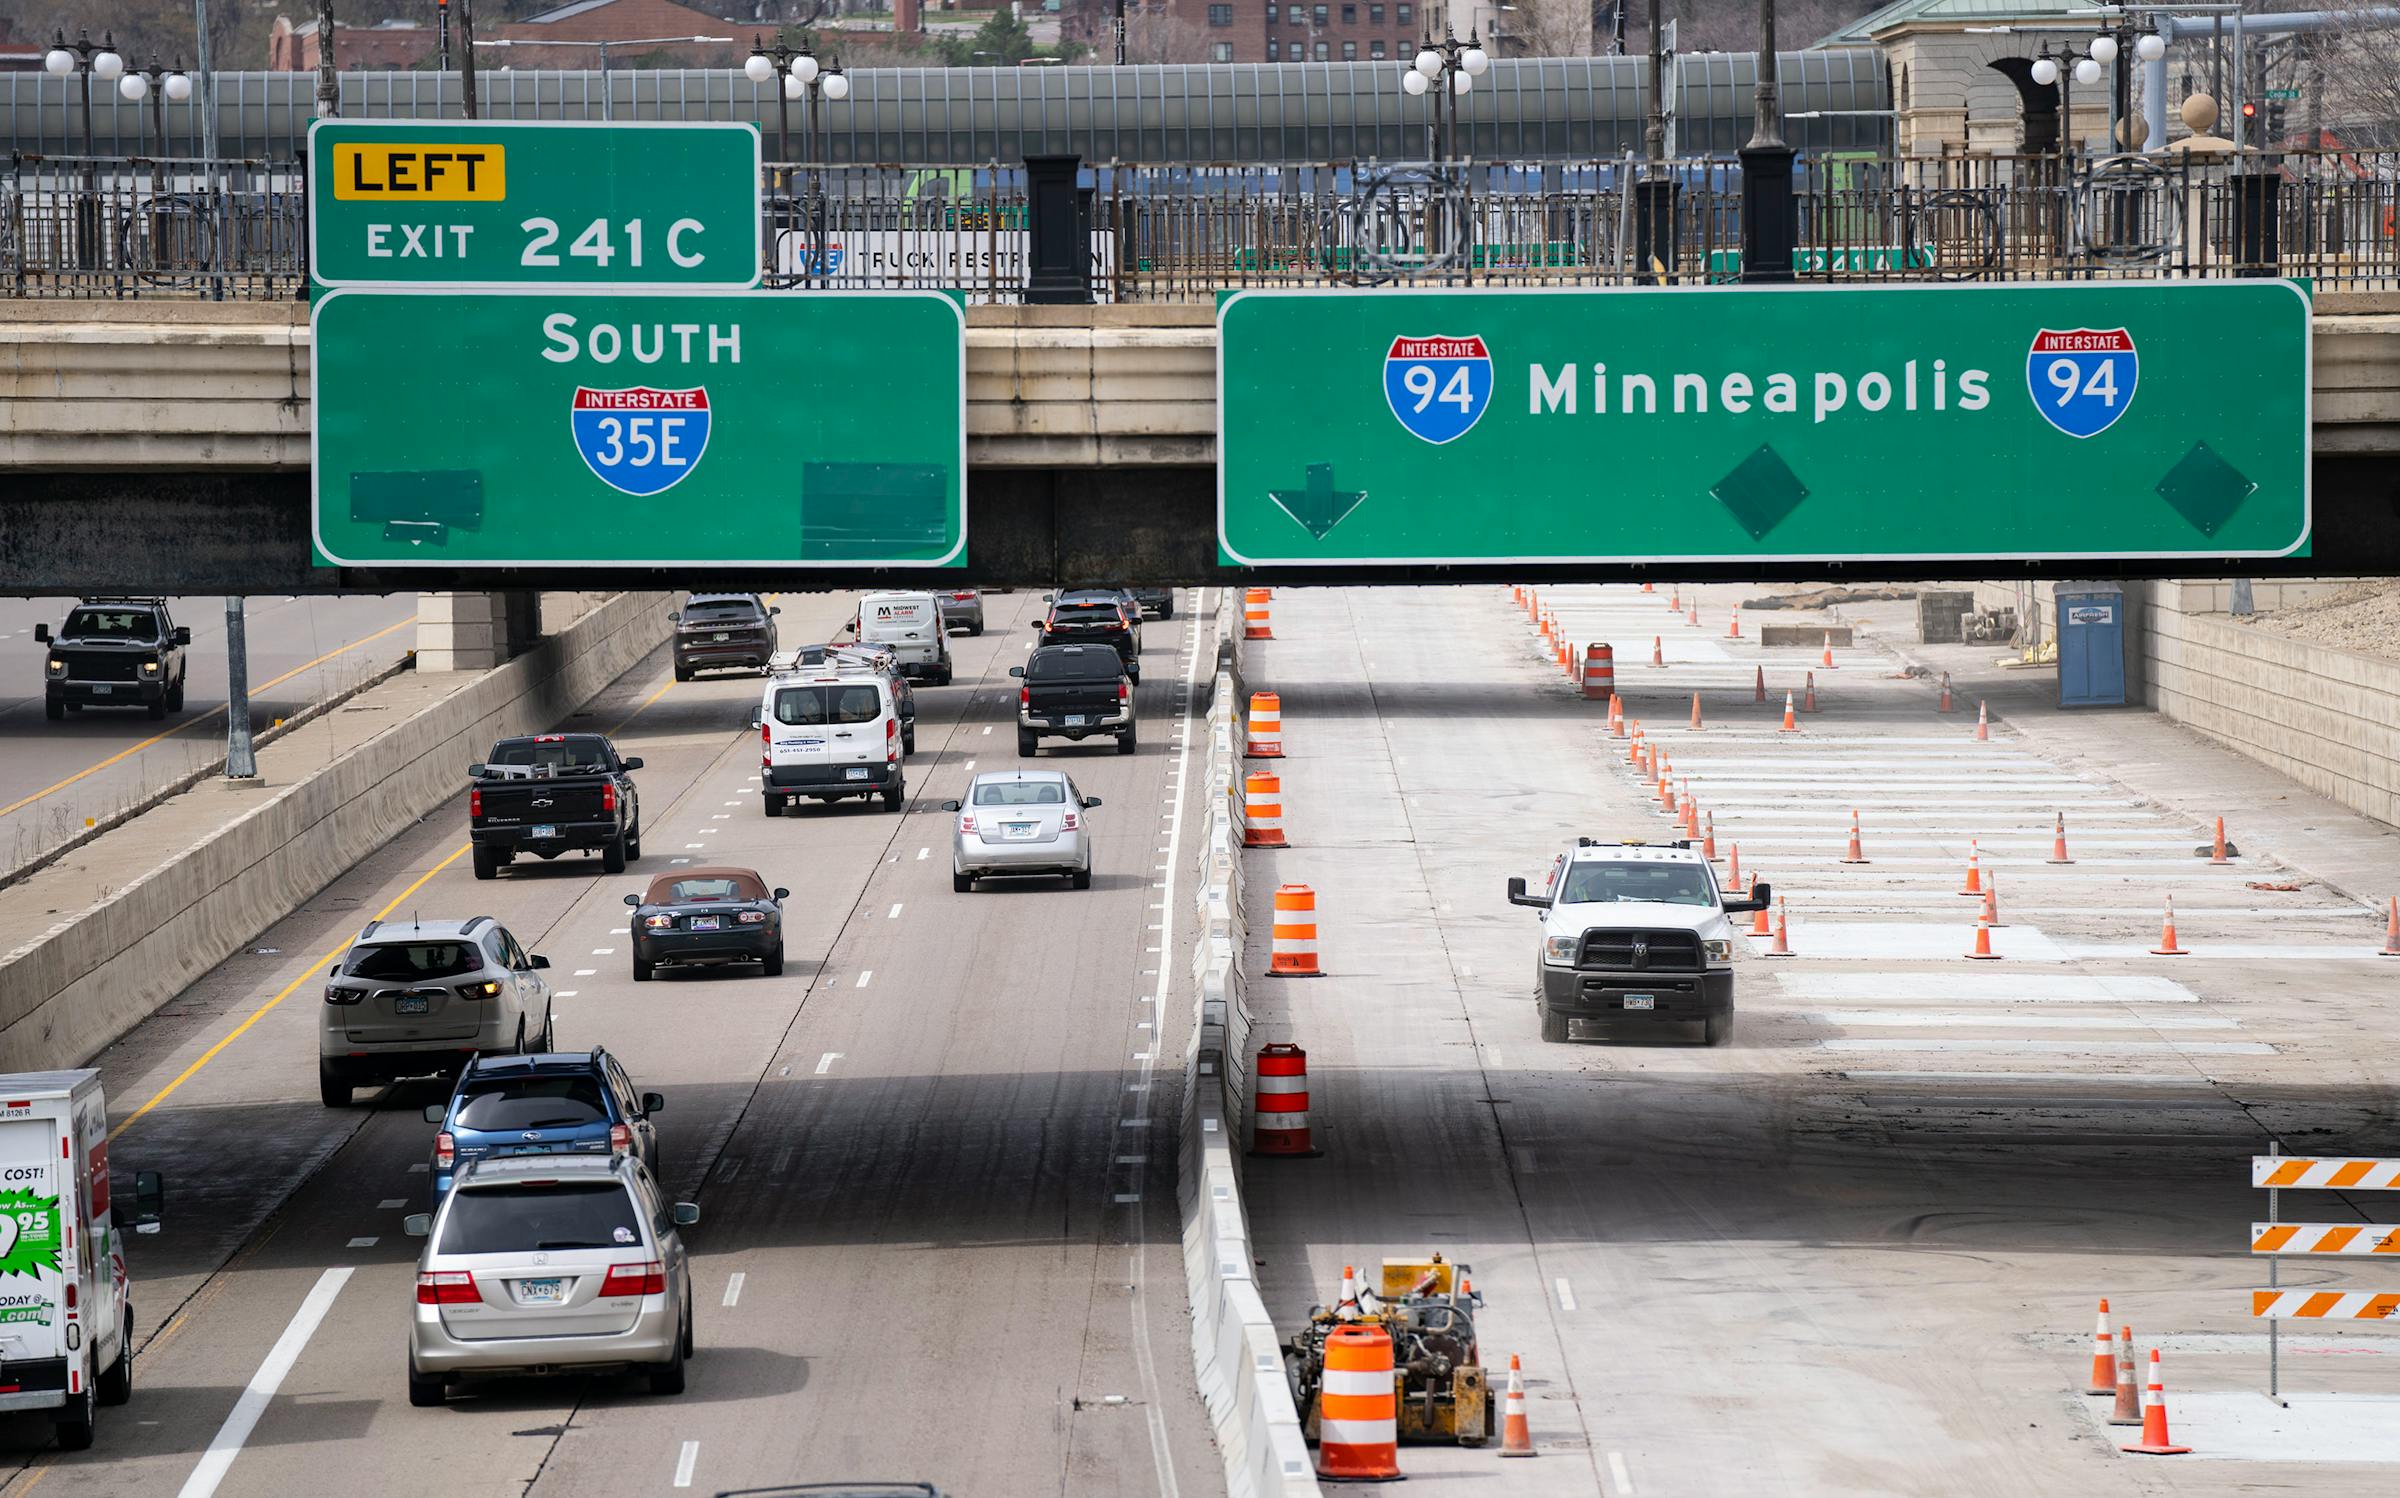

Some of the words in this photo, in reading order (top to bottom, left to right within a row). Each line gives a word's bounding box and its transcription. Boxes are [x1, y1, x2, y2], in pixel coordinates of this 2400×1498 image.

[353, 152, 486, 192] LEFT
[367, 224, 474, 258] EXIT
[521, 217, 643, 267] 241
[667, 218, 706, 268] C
[541, 313, 741, 363] SOUTH
[1400, 341, 1475, 357] INTERSTATE
[2044, 333, 2119, 350] INTERSTATE
[586, 391, 697, 409] INTERSTATE
[1404, 364, 1473, 413] 94
[1529, 359, 1990, 424] Minneapolis
[2046, 358, 2118, 407] 94
[596, 417, 687, 467] 35E
[4, 1168, 45, 1181] COST!
[17, 1210, 49, 1231] 95
